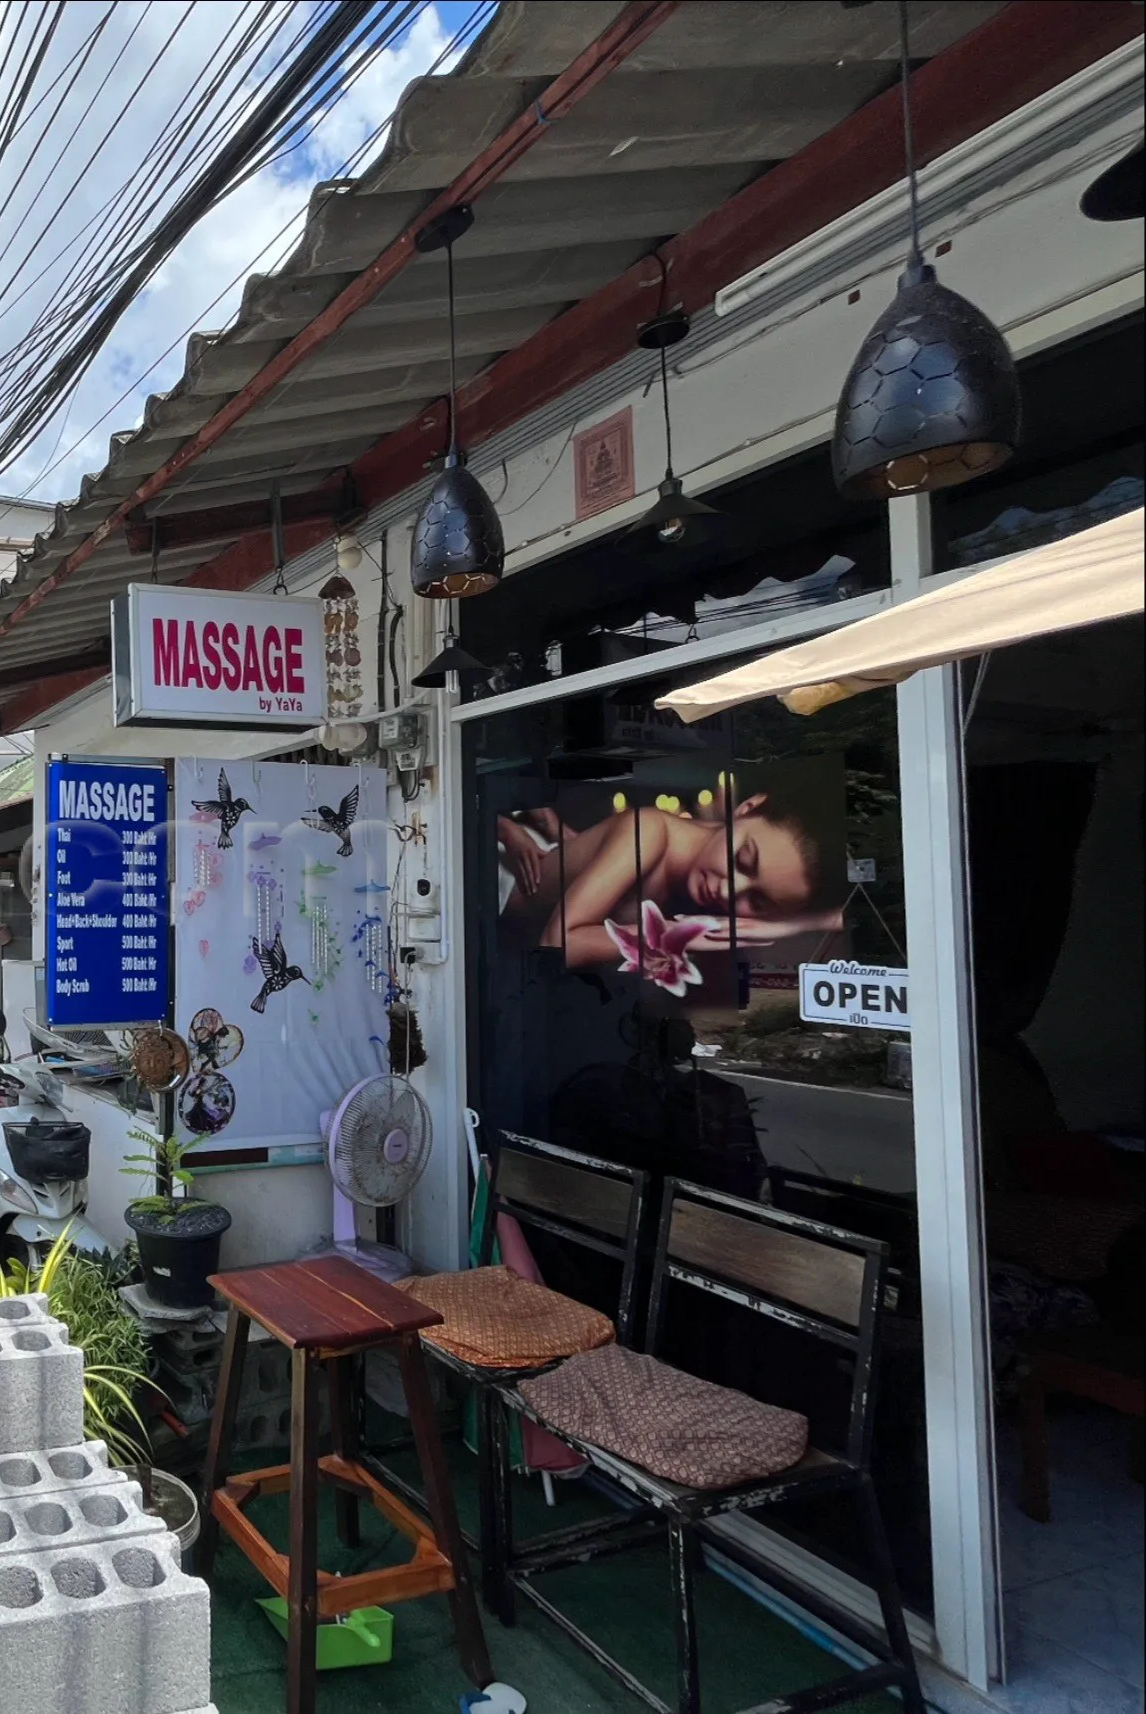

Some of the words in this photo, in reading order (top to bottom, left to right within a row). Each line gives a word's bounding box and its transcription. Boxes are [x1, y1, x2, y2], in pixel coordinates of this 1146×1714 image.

[152, 618, 305, 694] MASSAGE
[259, 697, 272, 713] by
[276, 698, 303, 712] YaYa
[59, 780, 155, 822] MASSAGE
[57, 828, 72, 842] Thai
[122, 831, 133, 845] 300
[57, 849, 66, 864] Oil
[122, 851, 133, 865] 300
[57, 871, 71, 885] Foot
[122, 872, 133, 886] 300
[57, 893, 70, 907] Aloe
[72, 893, 85, 907] Vera
[122, 893, 133, 907] 400
[122, 914, 133, 928] 400
[56, 936, 74, 953] Sport
[122, 935, 133, 949] 500
[56, 957, 68, 972] Hot
[69, 957, 77, 972] Oil
[122, 957, 133, 970] 500
[830, 962, 887, 977] Welcome
[56, 979, 71, 997] Body
[72, 978, 90, 993] Scrub
[122, 977, 133, 992] 500
[813, 980, 907, 1014] OPEN
